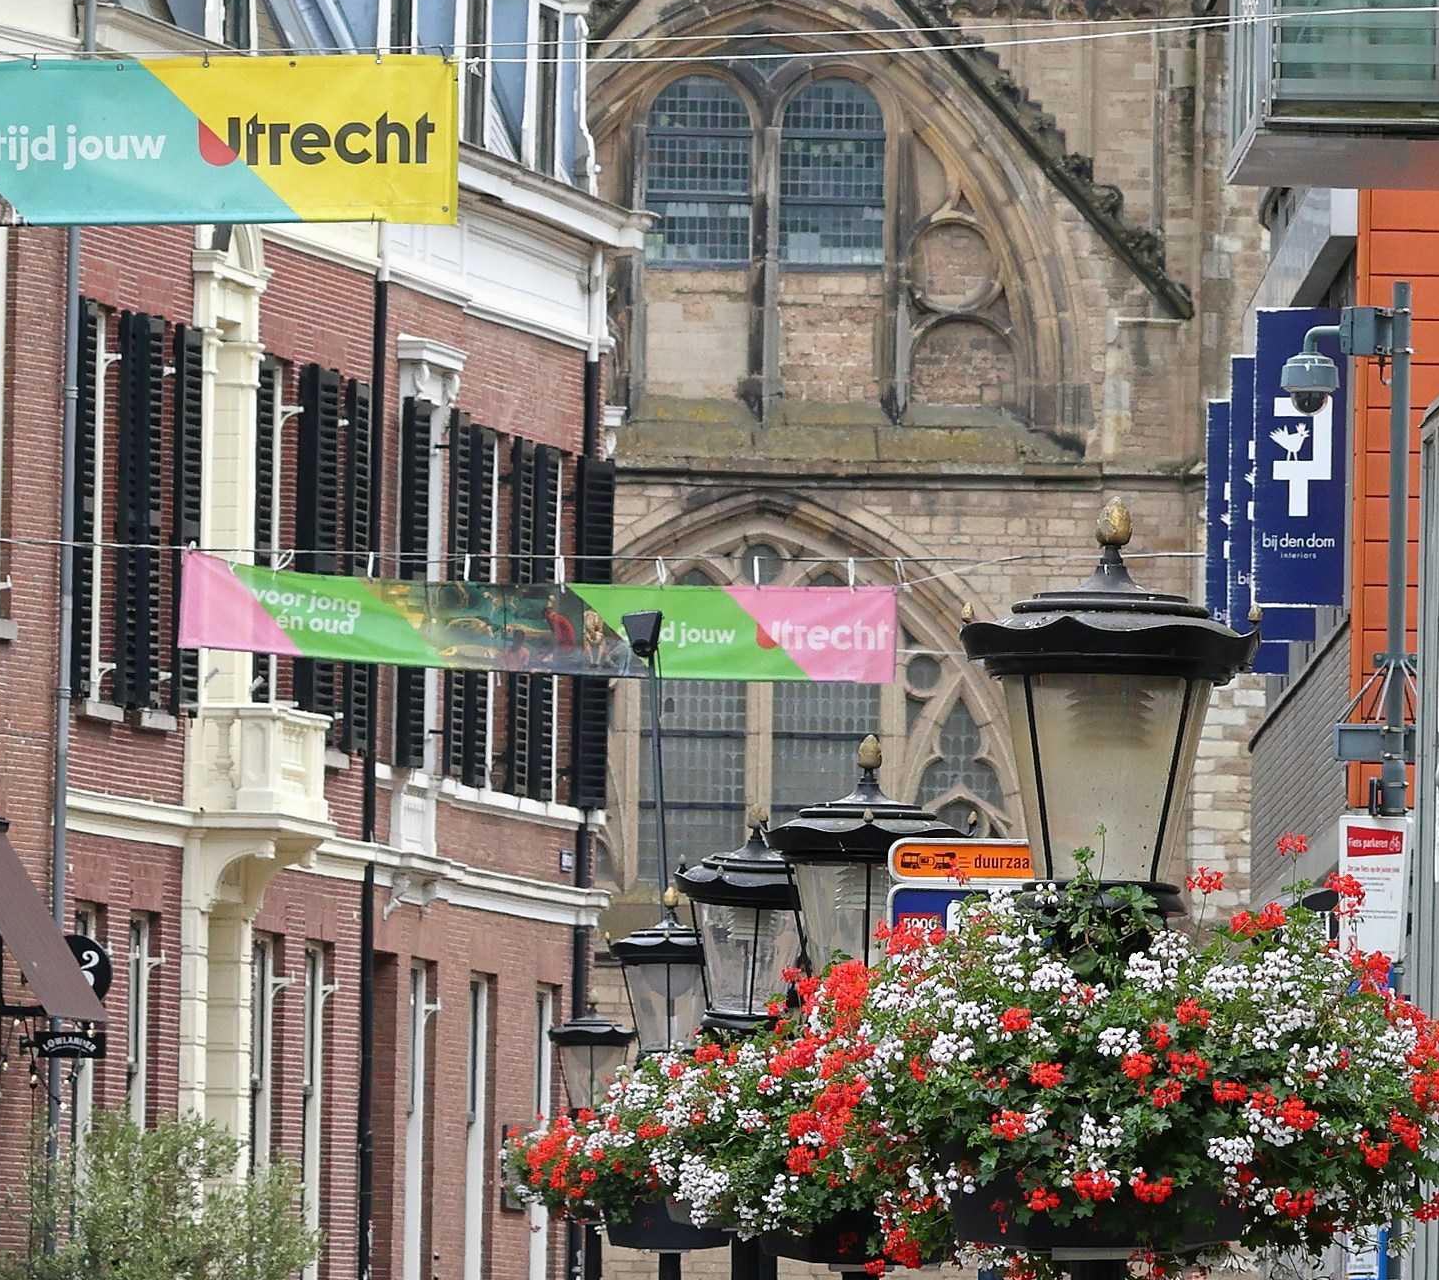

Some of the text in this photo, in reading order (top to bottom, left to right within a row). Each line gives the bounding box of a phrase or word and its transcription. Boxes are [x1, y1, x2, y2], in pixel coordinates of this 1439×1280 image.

[63, 124, 167, 171] jouw
[197, 110, 436, 167] Utrecht
[1262, 532, 1335, 552] bij den dom
[251, 588, 361, 619] voor jong
[276, 608, 356, 635] én oud
[678, 621, 737, 649] jouw
